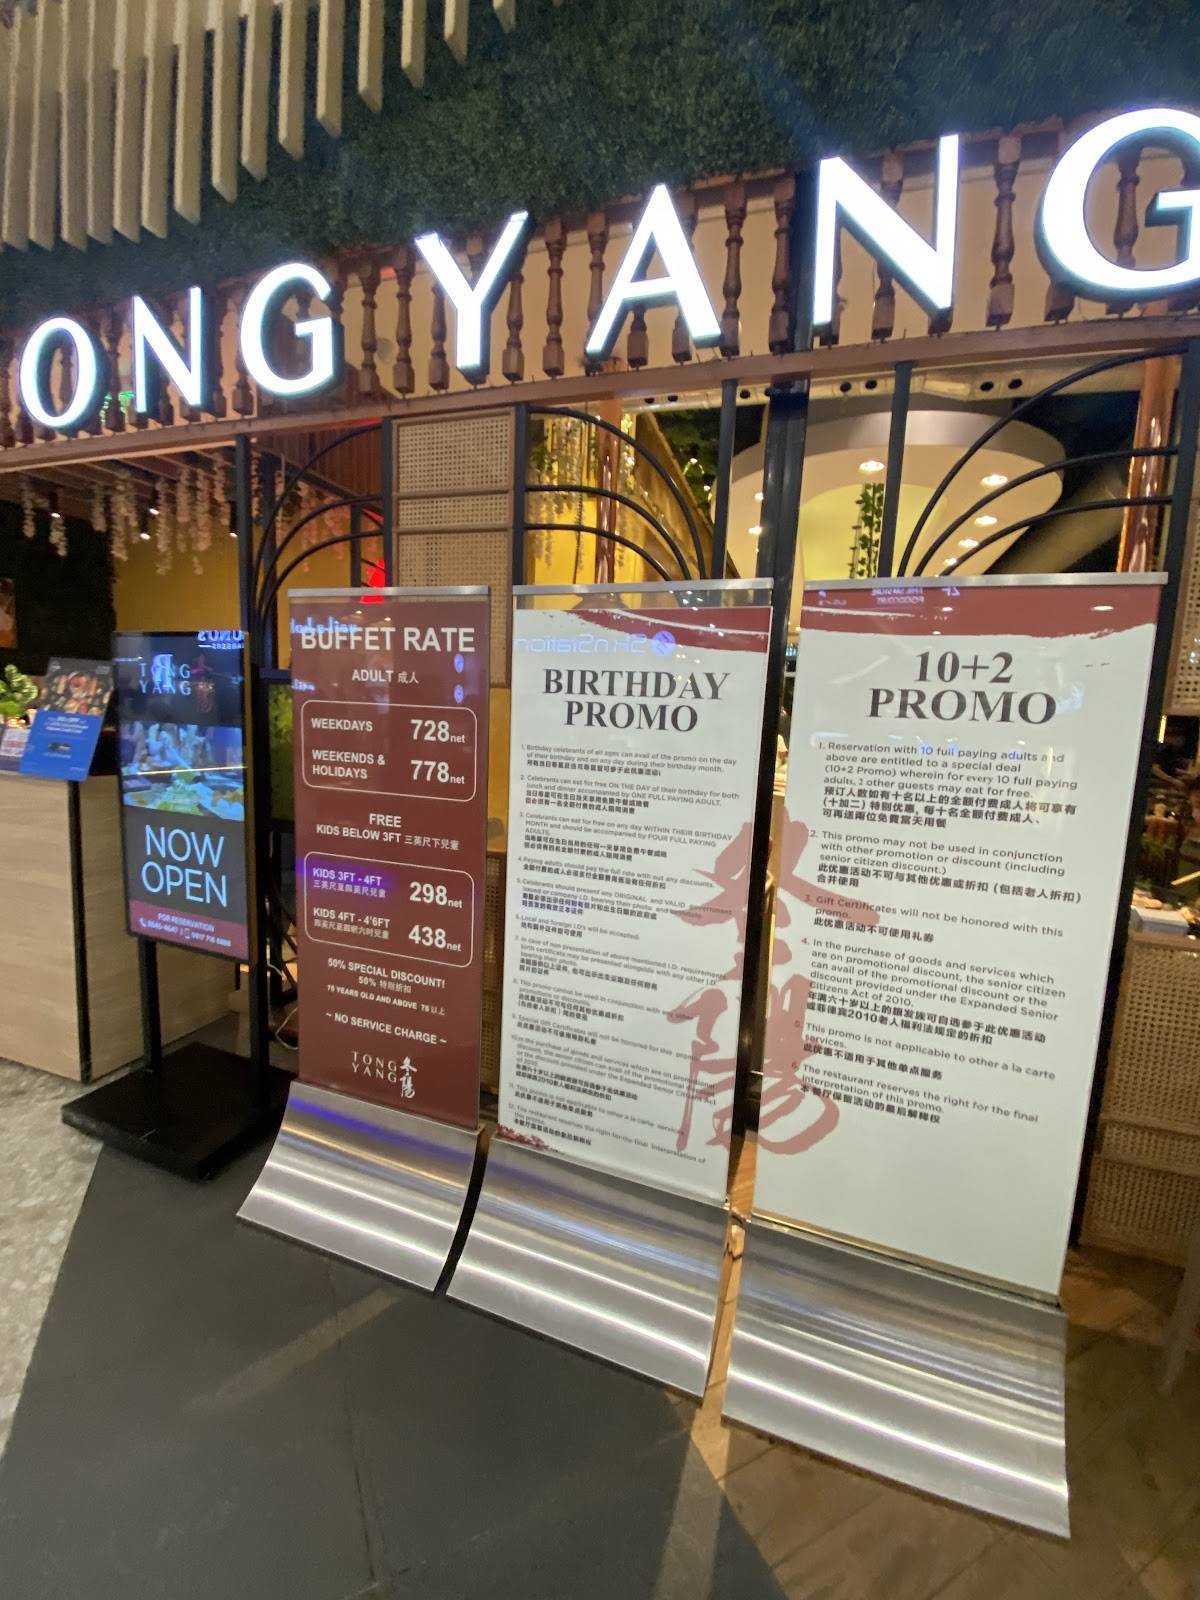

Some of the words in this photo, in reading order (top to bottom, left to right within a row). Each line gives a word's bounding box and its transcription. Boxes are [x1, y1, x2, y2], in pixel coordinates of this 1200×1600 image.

[415, 106, 1200, 371] YANG
[301, 626, 395, 650] BUFFET
[403, 626, 475, 653] RATE
[351, 669, 393, 682] ADULT
[915, 650, 1013, 684] 10+2
[543, 668, 731, 700] BIRTHDAY
[564, 700, 698, 732] PROMO
[869, 688, 1056, 724] PROMO
[311, 717, 372, 732] WEEKDAYS
[312, 749, 374, 764] WEEKENDS
[377, 754, 385, 765] &
[825, 752, 857, 762] above
[860, 756, 877, 764] are
[880, 755, 922, 766] entitled
[926, 759, 938, 767] to
[951, 759, 992, 771] special
[995, 762, 1021, 772] deal
[828, 741, 890, 753] Reservation
[894, 744, 917, 754] with
[920, 746, 933, 755] 10
[936, 747, 955, 756] full
[957, 748, 997, 760] paying
[1000, 750, 1037, 761] adults
[312, 764, 367, 779] HOLIDAYS
[667, 763, 696, 771] birthday
[824, 764, 853, 774] (10+2
[856, 766, 896, 777] Promo)
[899, 768, 943, 780] wherein
[946, 771, 964, 781] for
[965, 775, 993, 785] every
[996, 775, 1010, 784] 10
[1013, 775, 1032, 786] full
[1035, 777, 1077, 790] paying
[631, 791, 647, 799] ONE
[648, 793, 666, 801] FULL
[667, 795, 694, 804] PAYING
[865, 777, 895, 788] other
[897, 781, 934, 792] guests
[937, 784, 961, 794] may
[964, 785, 983, 794] eat
[986, 786, 1004, 796] for
[1006, 787, 1033, 798] free.
[369, 813, 401, 828] FREE
[316, 823, 339, 836] KIDS
[342, 826, 379, 841] BELOW
[382, 831, 401, 843] 3FT
[145, 825, 224, 868] NOW
[809, 829, 818, 837] 2.
[821, 830, 842, 840] This
[845, 834, 879, 845] promo
[882, 838, 905, 848] may
[908, 839, 927, 849] not
[930, 841, 945, 851] be
[947, 843, 975, 854] used
[978, 846, 989, 855] in
[992, 847, 1063, 864] conjunction
[819, 852, 851, 863] senior
[853, 855, 888, 868] citizen
[891, 860, 946, 875] discount.)
[820, 841, 842, 851] with
[845, 844, 873, 855] other
[876, 847, 933, 862] promotion
[936, 855, 948, 863] or
[951, 855, 1001, 869] discount
[1004, 860, 1065, 877] (including
[142, 861, 227, 907] OPEN
[313, 867, 334, 880] KIDS
[338, 871, 355, 883] 3FT
[364, 874, 382, 886] 4FT
[313, 907, 335, 920] KIDS
[337, 911, 355, 923] 4FT
[364, 915, 390, 929] 4'6FT
[816, 894, 834, 905] Gift
[837, 898, 897, 914] Certificates
[899, 906, 918, 917] will
[921, 910, 940, 920] not
[943, 913, 958, 923] be
[960, 914, 1009, 930] honored
[1012, 921, 1038, 933] with
[1041, 926, 1063, 937] this
[327, 957, 345, 969] 50%
[348, 961, 387, 977] SPECIAL
[391, 969, 445, 988] DISCOUNT!
[813, 938, 822, 947] In
[825, 940, 841, 950] the
[844, 943, 891, 959] purchase
[894, 951, 905, 961] of
[907, 953, 942, 968] goods
[945, 959, 966, 970] and
[969, 963, 1016, 978] services
[1018, 970, 1054, 984] which
[336, 986, 358, 997] YEARS
[360, 991, 374, 1000] OLD
[376, 994, 390, 1004] AND
[392, 997, 416, 1009] ABOVE
[334, 1012, 348, 1024] NO
[350, 1016, 391, 1033] SERVICE
[394, 1025, 436, 1043] CHARGE
[352, 1050, 397, 1071] TONG
[351, 1062, 396, 1083] YANG
